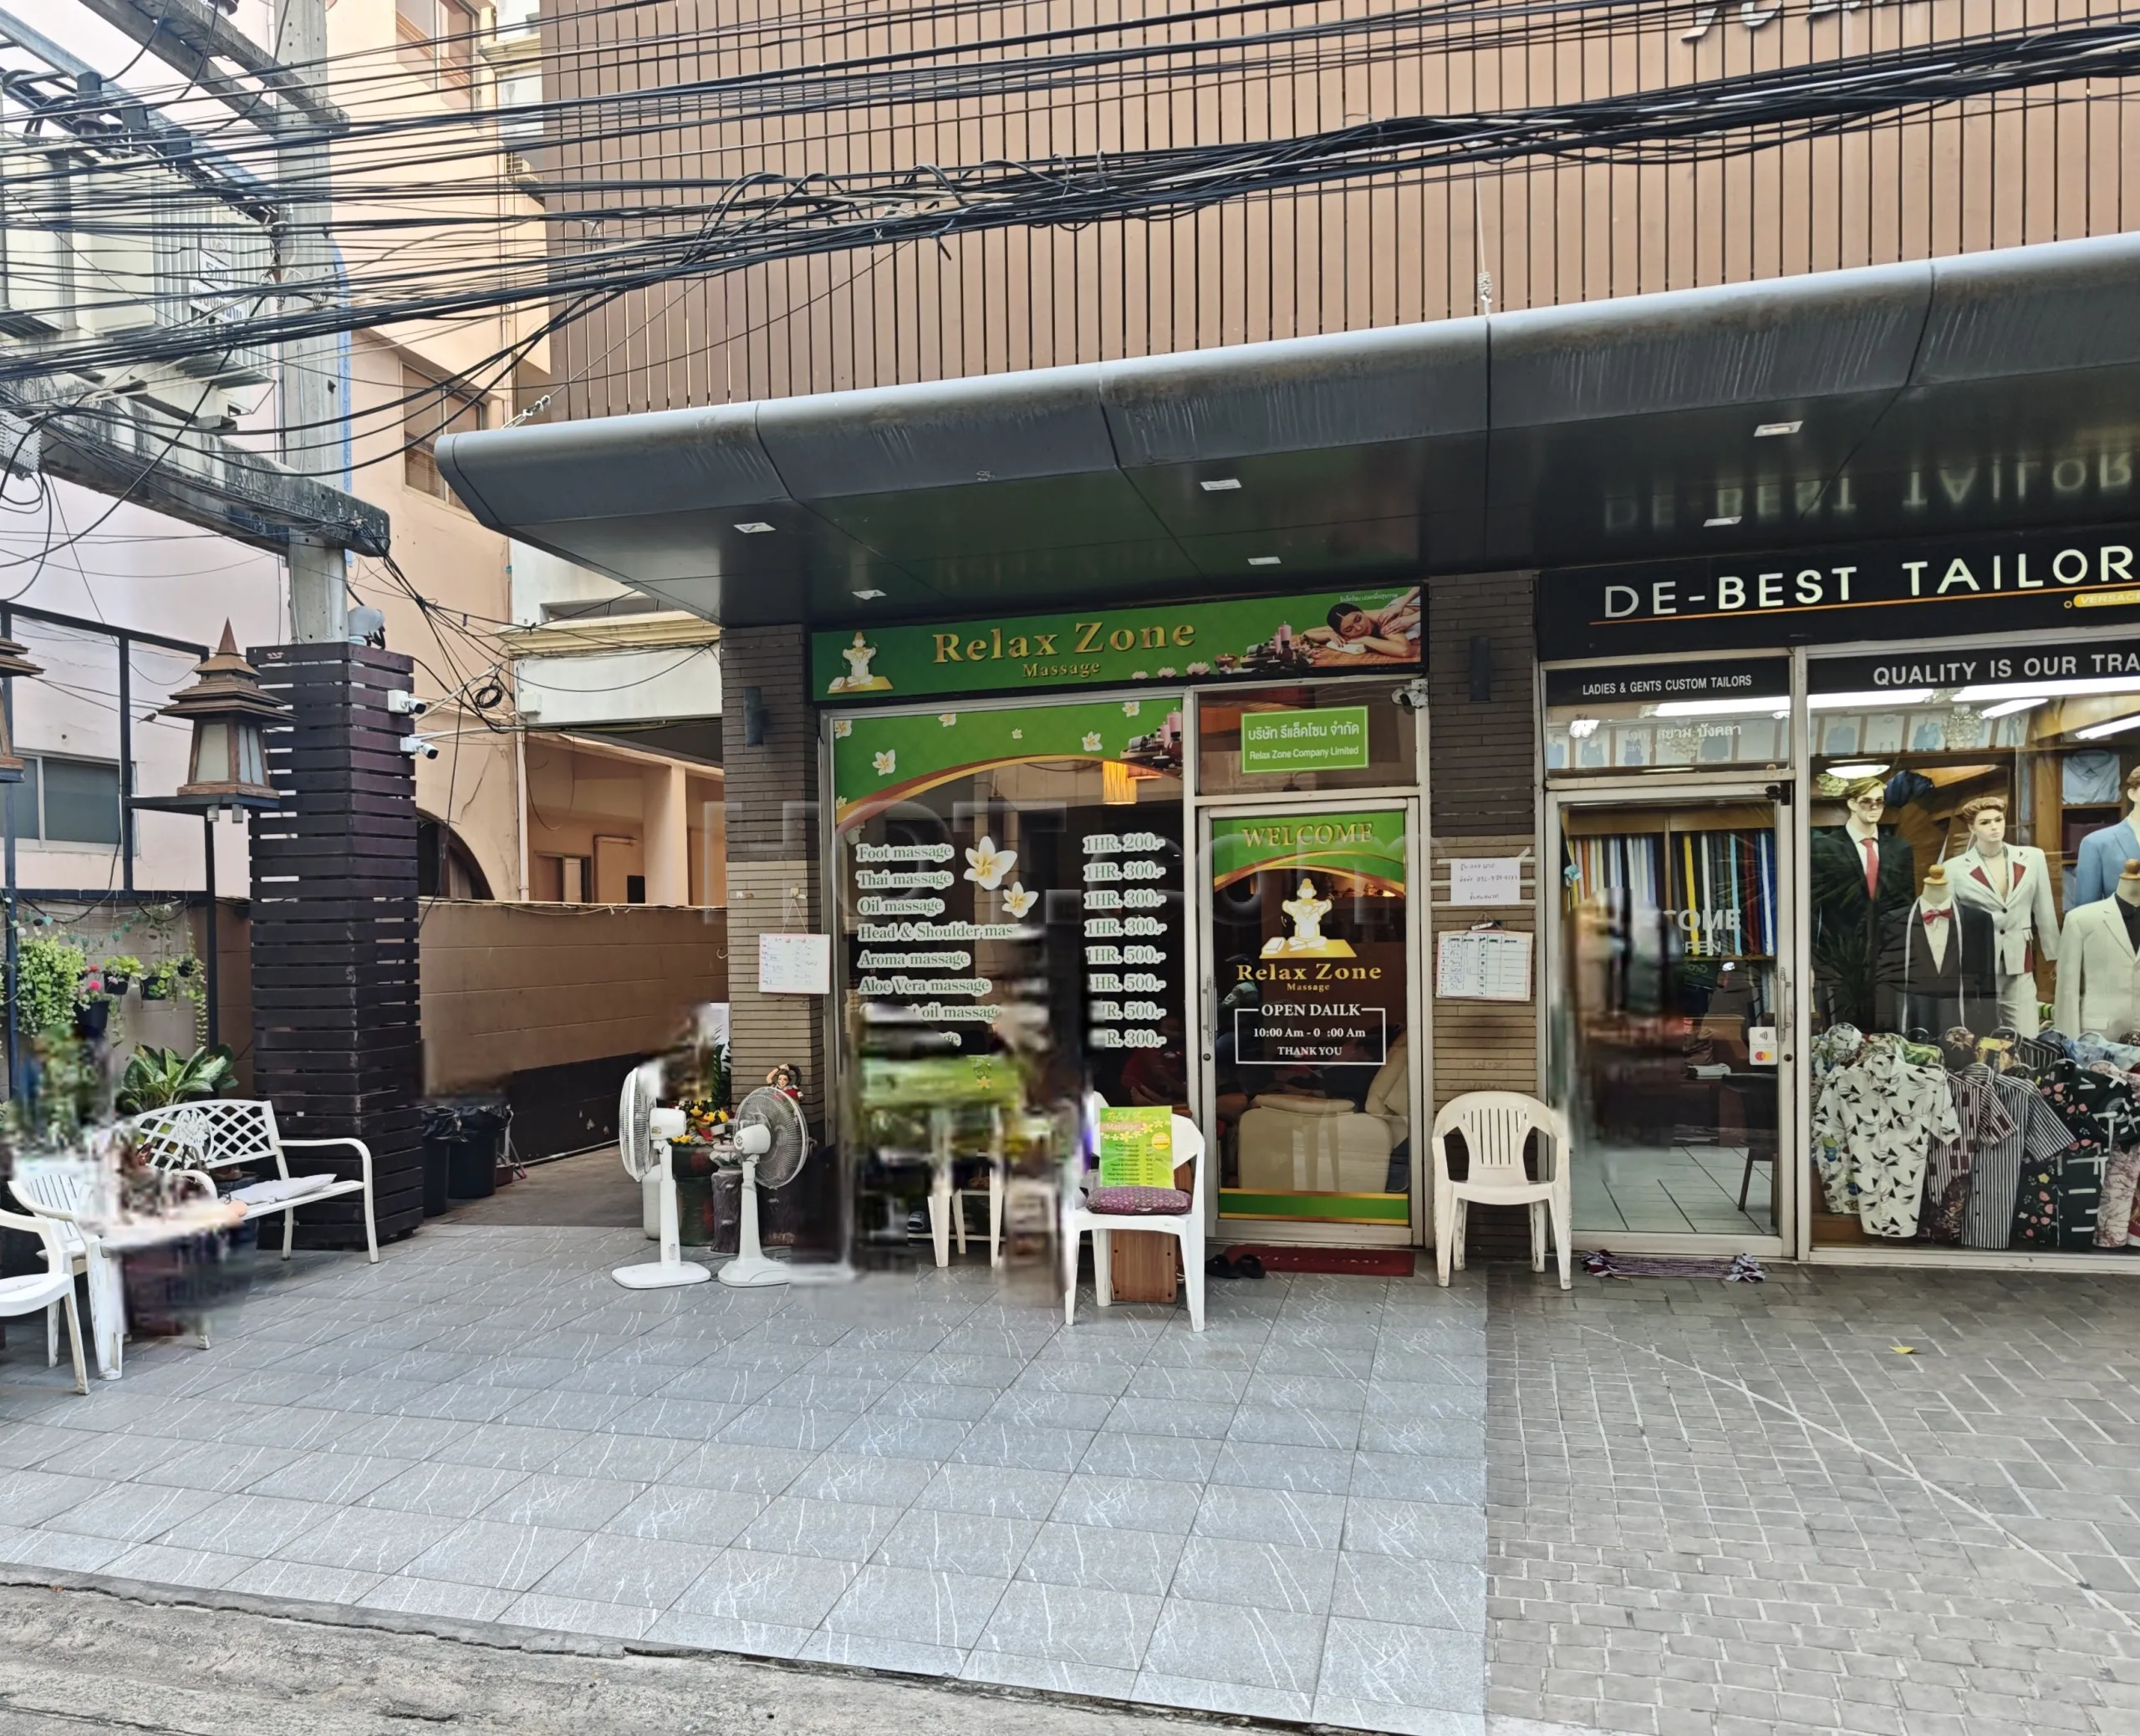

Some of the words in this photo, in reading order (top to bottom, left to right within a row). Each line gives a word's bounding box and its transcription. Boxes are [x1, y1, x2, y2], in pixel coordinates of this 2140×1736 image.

[1604, 567, 1857, 619] DE-BEST
[1903, 545, 2133, 597] TAILOR
[932, 628, 1059, 664] Relax
[1075, 621, 1195, 654] Zone
[1022, 661, 1101, 678] Massage
[1873, 662, 1976, 685] QUALITY
[1990, 659, 2012, 678] IS
[2024, 656, 2076, 676] OUR
[1582, 682, 1616, 695] LADIES
[1619, 682, 1626, 693] &
[1630, 680, 1662, 693] GENTS
[1665, 677, 1707, 691] CUSTOM
[1711, 675, 1752, 687] TAILORS
[1248, 725, 1277, 741] บริษัท
[1281, 721, 1327, 740] รีแล็คโซน
[1330, 720, 1359, 736] จำกัด
[1250, 751, 1271, 760] Relax
[1271, 749, 1292, 759] Zone
[1292, 747, 1329, 759] Company
[1330, 746, 1359, 756] Limited
[1241, 822, 1374, 848] WELCOME
[1086, 837, 1121, 852] 1HR.
[1126, 835, 1164, 849] 200.-
[860, 845, 890, 859] Foot
[894, 846, 952, 861] massage
[1087, 866, 1121, 879] 1HR.
[1126, 863, 1164, 878] 300.-
[860, 873, 890, 886] Thai
[894, 873, 952, 888] massage
[860, 899, 880, 913] Oil
[884, 899, 943, 915] massage
[1088, 893, 1121, 908] 1HR.
[1126, 891, 1164, 905] 300.-
[861, 924, 896, 939] Head
[901, 926, 913, 938] &
[917, 924, 981, 938] Shoulder
[1088, 922, 1122, 935] 1HR.
[1126, 919, 1164, 934] 300.-
[1127, 947, 1165, 962] 500.-
[1683, 941, 1722, 953] PEN
[861, 953, 905, 965] Aroma
[910, 953, 968, 968] massage
[1236, 964, 1307, 980] Relax
[1316, 963, 1382, 980] Zone
[861, 979, 890, 992] Aloe
[893, 979, 926, 992] Vera
[930, 980, 990, 995] massage
[1127, 975, 1165, 989] 500.-
[1287, 983, 1330, 992] Massage
[922, 1004, 940, 1017] oil
[1127, 1002, 1165, 1016] 500.-
[1261, 1004, 1306, 1016] OPEN
[1310, 1004, 1361, 1016] DAILK
[1127, 1031, 1165, 1045] 300.-
[1253, 1028, 1282, 1037] 10:00
[1284, 1028, 1304, 1037] Am
[1346, 1028, 1366, 1037] Am
[1277, 1046, 1319, 1056] THANK
[1319, 1046, 1343, 1056] YOU
